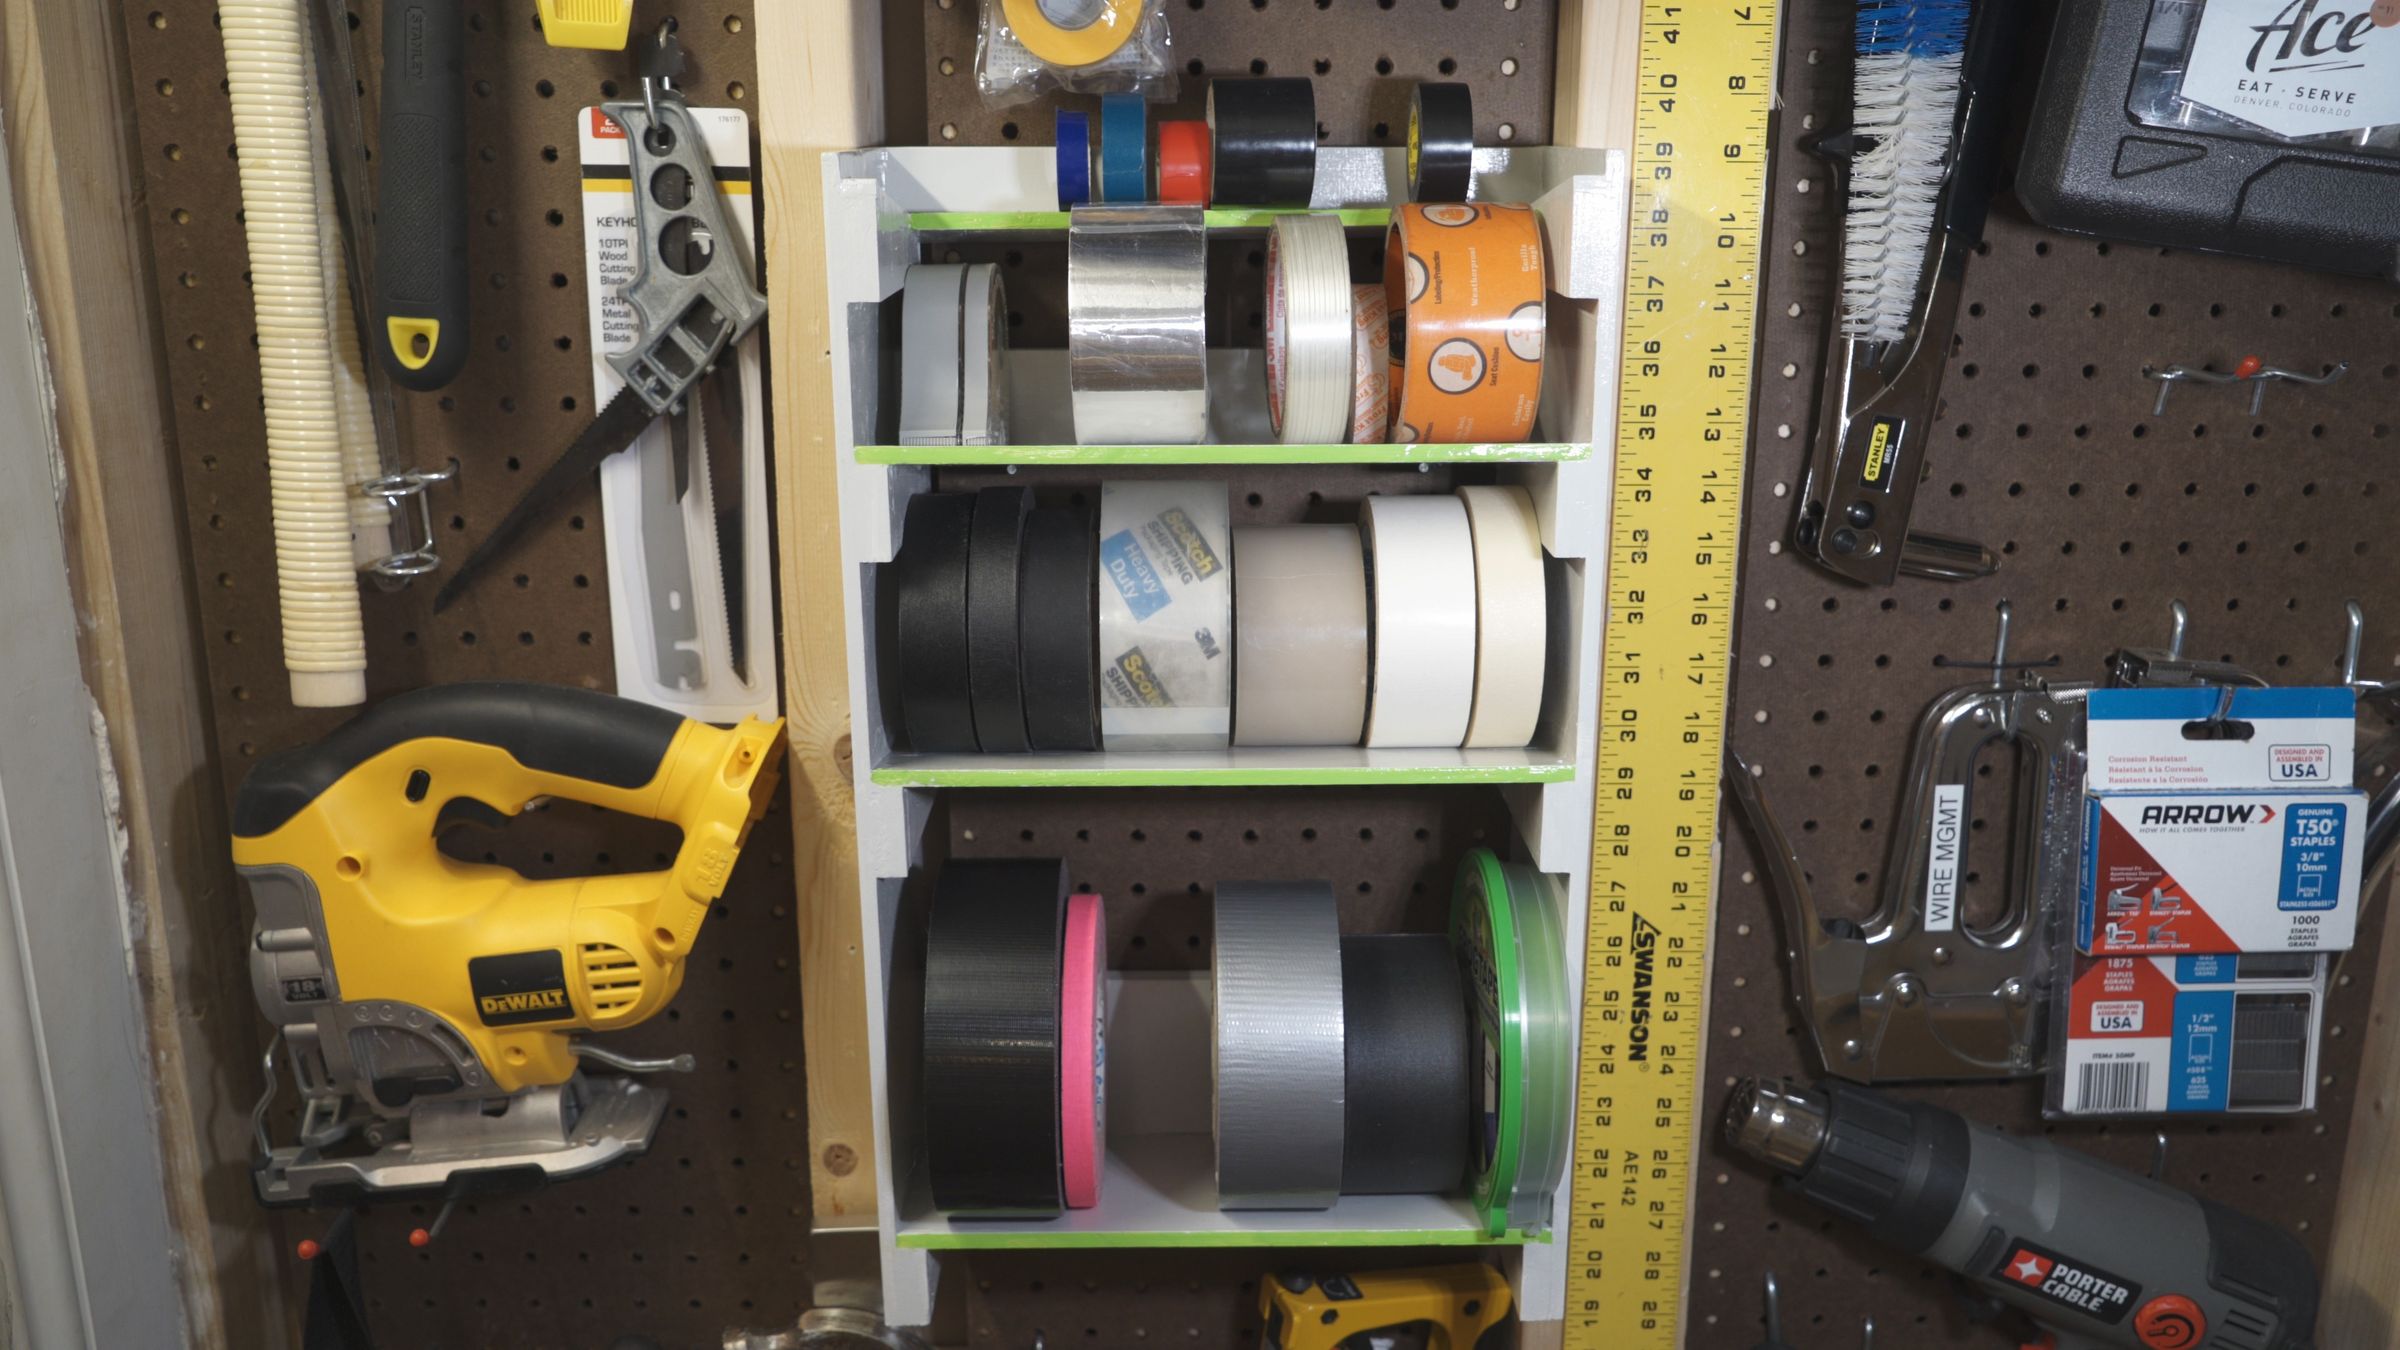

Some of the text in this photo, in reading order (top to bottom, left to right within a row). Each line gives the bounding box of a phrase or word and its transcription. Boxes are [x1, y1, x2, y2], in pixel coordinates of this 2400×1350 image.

[2246, 0, 2376, 72] Ace
[410, 12, 422, 79] STANLEY
[2238, 79, 2358, 104] EAT SERVE
[2288, 103, 2352, 117] COLORADO
[598, 252, 628, 261] Wood
[1520, 244, 1529, 272] Gorilla
[1528, 245, 1538, 271] Tough
[599, 264, 636, 275] Cutting
[1468, 247, 1479, 307] Weatherproof
[600, 276, 628, 285] Blade
[602, 309, 631, 318] Metal
[602, 321, 639, 333] Cutting
[603, 333, 631, 343] Blade
[1489, 372, 1497, 387] Seat
[1868, 428, 1886, 478] STANLEY
[1147, 519, 1194, 586] SHIPPING
[1166, 510, 1214, 577] Scotch
[1124, 542, 1160, 594] Heavy
[1110, 557, 1140, 600] Duty
[1195, 627, 1221, 661] 3M
[2108, 755, 2148, 763] Corrosion
[2164, 765, 2204, 773] Corrosion
[2281, 764, 2318, 778] USA
[2141, 804, 2256, 825] ARROW
[2298, 808, 2333, 816] GENUINE
[2290, 837, 2336, 847] STAPLES
[1930, 795, 1958, 923] WIRE MGMT
[2296, 863, 2327, 872] 10mm
[2292, 915, 2320, 925] 1000
[2107, 958, 2133, 968] 1875
[1628, 930, 1655, 1062] SWANSON
[2100, 1017, 2132, 1029] USA
[2187, 1024, 2218, 1033] 12mm
[1621, 1150, 1639, 1207] AE142
[2052, 1264, 2129, 1305] PORTER
[2042, 1280, 2103, 1312] CABLE
